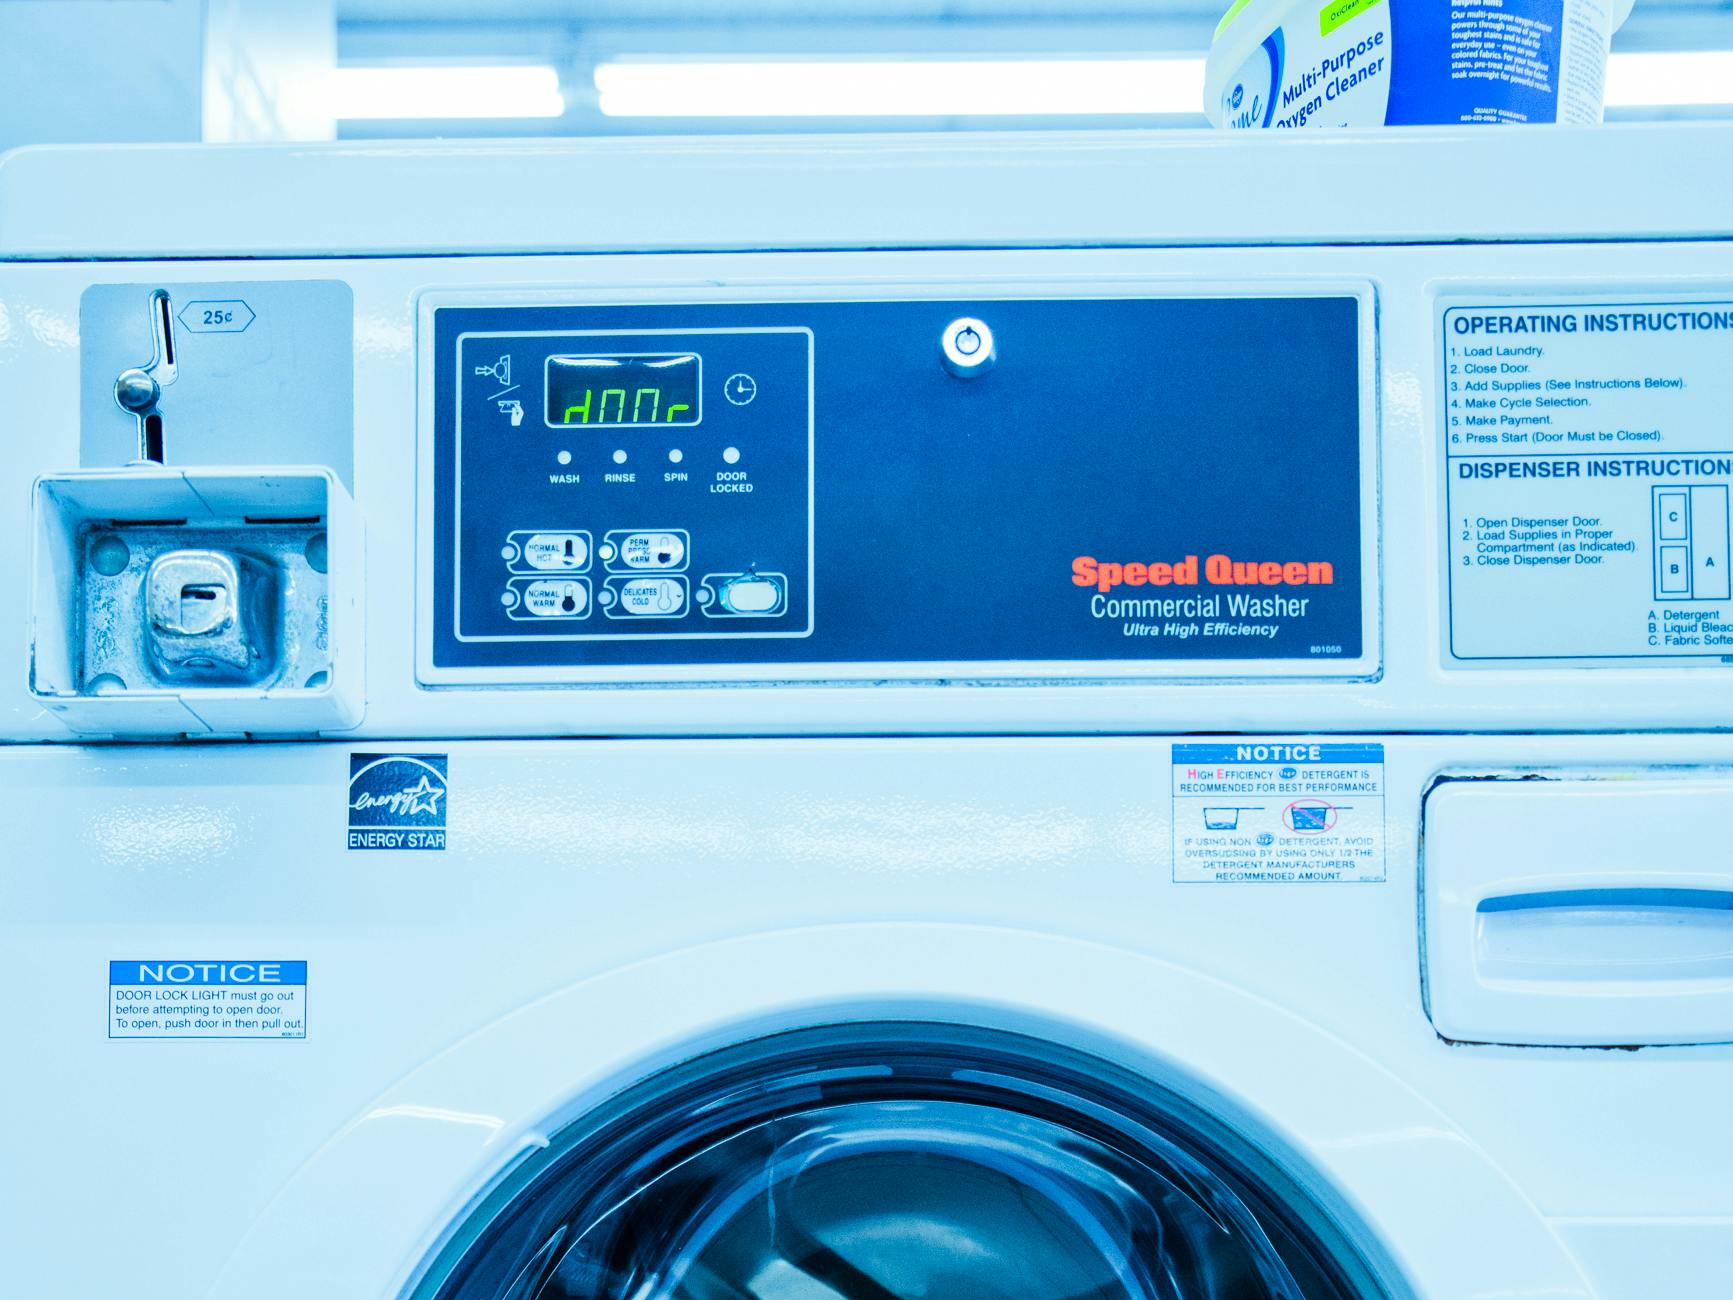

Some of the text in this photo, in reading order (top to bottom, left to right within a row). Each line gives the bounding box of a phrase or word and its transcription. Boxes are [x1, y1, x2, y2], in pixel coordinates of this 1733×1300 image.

[1451, 21, 1477, 31] powers
[1451, 30, 1482, 40] toughest
[1451, 40, 1482, 50] everyday
[1282, 31, 1384, 109] Multi-Purpose
[1325, 57, 1385, 101] Cleaner
[203, 310, 233, 325] 25¢
[1453, 314, 1577, 335] OPERATING
[1451, 345, 1545, 358] 1. Load Laundry.
[1450, 362, 1531, 374] 2. Close Door.
[1450, 377, 1687, 392] 3. Add Supplies (See Instructions Below).
[1451, 396, 1592, 410] 4. Make Cycle Selection.
[1451, 414, 1553, 427] 5. Make Payment.
[1452, 433, 1462, 444] 6.
[1466, 432, 1498, 443] Press
[1501, 432, 1528, 443] Start
[1532, 431, 1564, 444] (Door
[1567, 431, 1596, 442] Must
[1598, 431, 1614, 441] be
[1459, 459, 1733, 479] DISPENSER INSTRUCTION
[549, 471, 748, 484] WASH RINSE SPIN DOOR
[709, 483, 754, 493] LOCKED
[1463, 515, 1603, 530] 1. Open Dispenser Door.
[1669, 511, 1678, 522] C
[1462, 528, 1614, 542] 2. Load Supplies in Proper
[1477, 542, 1555, 555] Compartment
[1558, 541, 1576, 553] (as
[1463, 553, 1605, 567] 3. Close Dispenser Door.
[1706, 556, 1715, 567] A
[1072, 554, 1333, 592] Speed Queen
[1671, 564, 1679, 574] B
[528, 587, 657, 598] NORMAL DELICATES
[532, 597, 649, 608] WARM COLD
[1091, 594, 1309, 618] Commercial Washer
[1648, 609, 1720, 622] A. Detergent
[1123, 622, 1279, 638] Ultra High Efficiency
[1648, 623, 1659, 633] B.
[1664, 622, 1698, 635] Liquid
[1648, 635, 1661, 646] C.
[1664, 635, 1700, 646] Fabric
[1236, 745, 1322, 761] NOTICE
[1187, 768, 1214, 780] HIGH
[1217, 768, 1273, 780] EFFICIENCY
[1302, 770, 1358, 780] DETERGENT
[1361, 770, 1370, 779] IS
[1180, 782, 1377, 793] RECOMMENDED FOR BEST PERFORMANCE
[350, 791, 426, 816] energy
[349, 832, 445, 848] ENERGY STAR
[1196, 837, 1227, 846] USING
[1229, 837, 1252, 846] NON
[1344, 836, 1374, 846] AVOID
[1260, 849, 1273, 858] BY
[1276, 848, 1307, 858] USING
[1309, 848, 1336, 858] ONLY
[1355, 848, 1374, 857] THE
[1203, 859, 1355, 869] DETERGENT MANUFACTURERS
[1216, 872, 1295, 881] RECOMMENDED
[139, 964, 281, 983] NOTICE
[116, 990, 294, 1003] DOOR LOCK LIGHT must go out
[115, 1004, 283, 1018] before attempting to open door.
[117, 1018, 304, 1032] To open, push door in then pull out.
